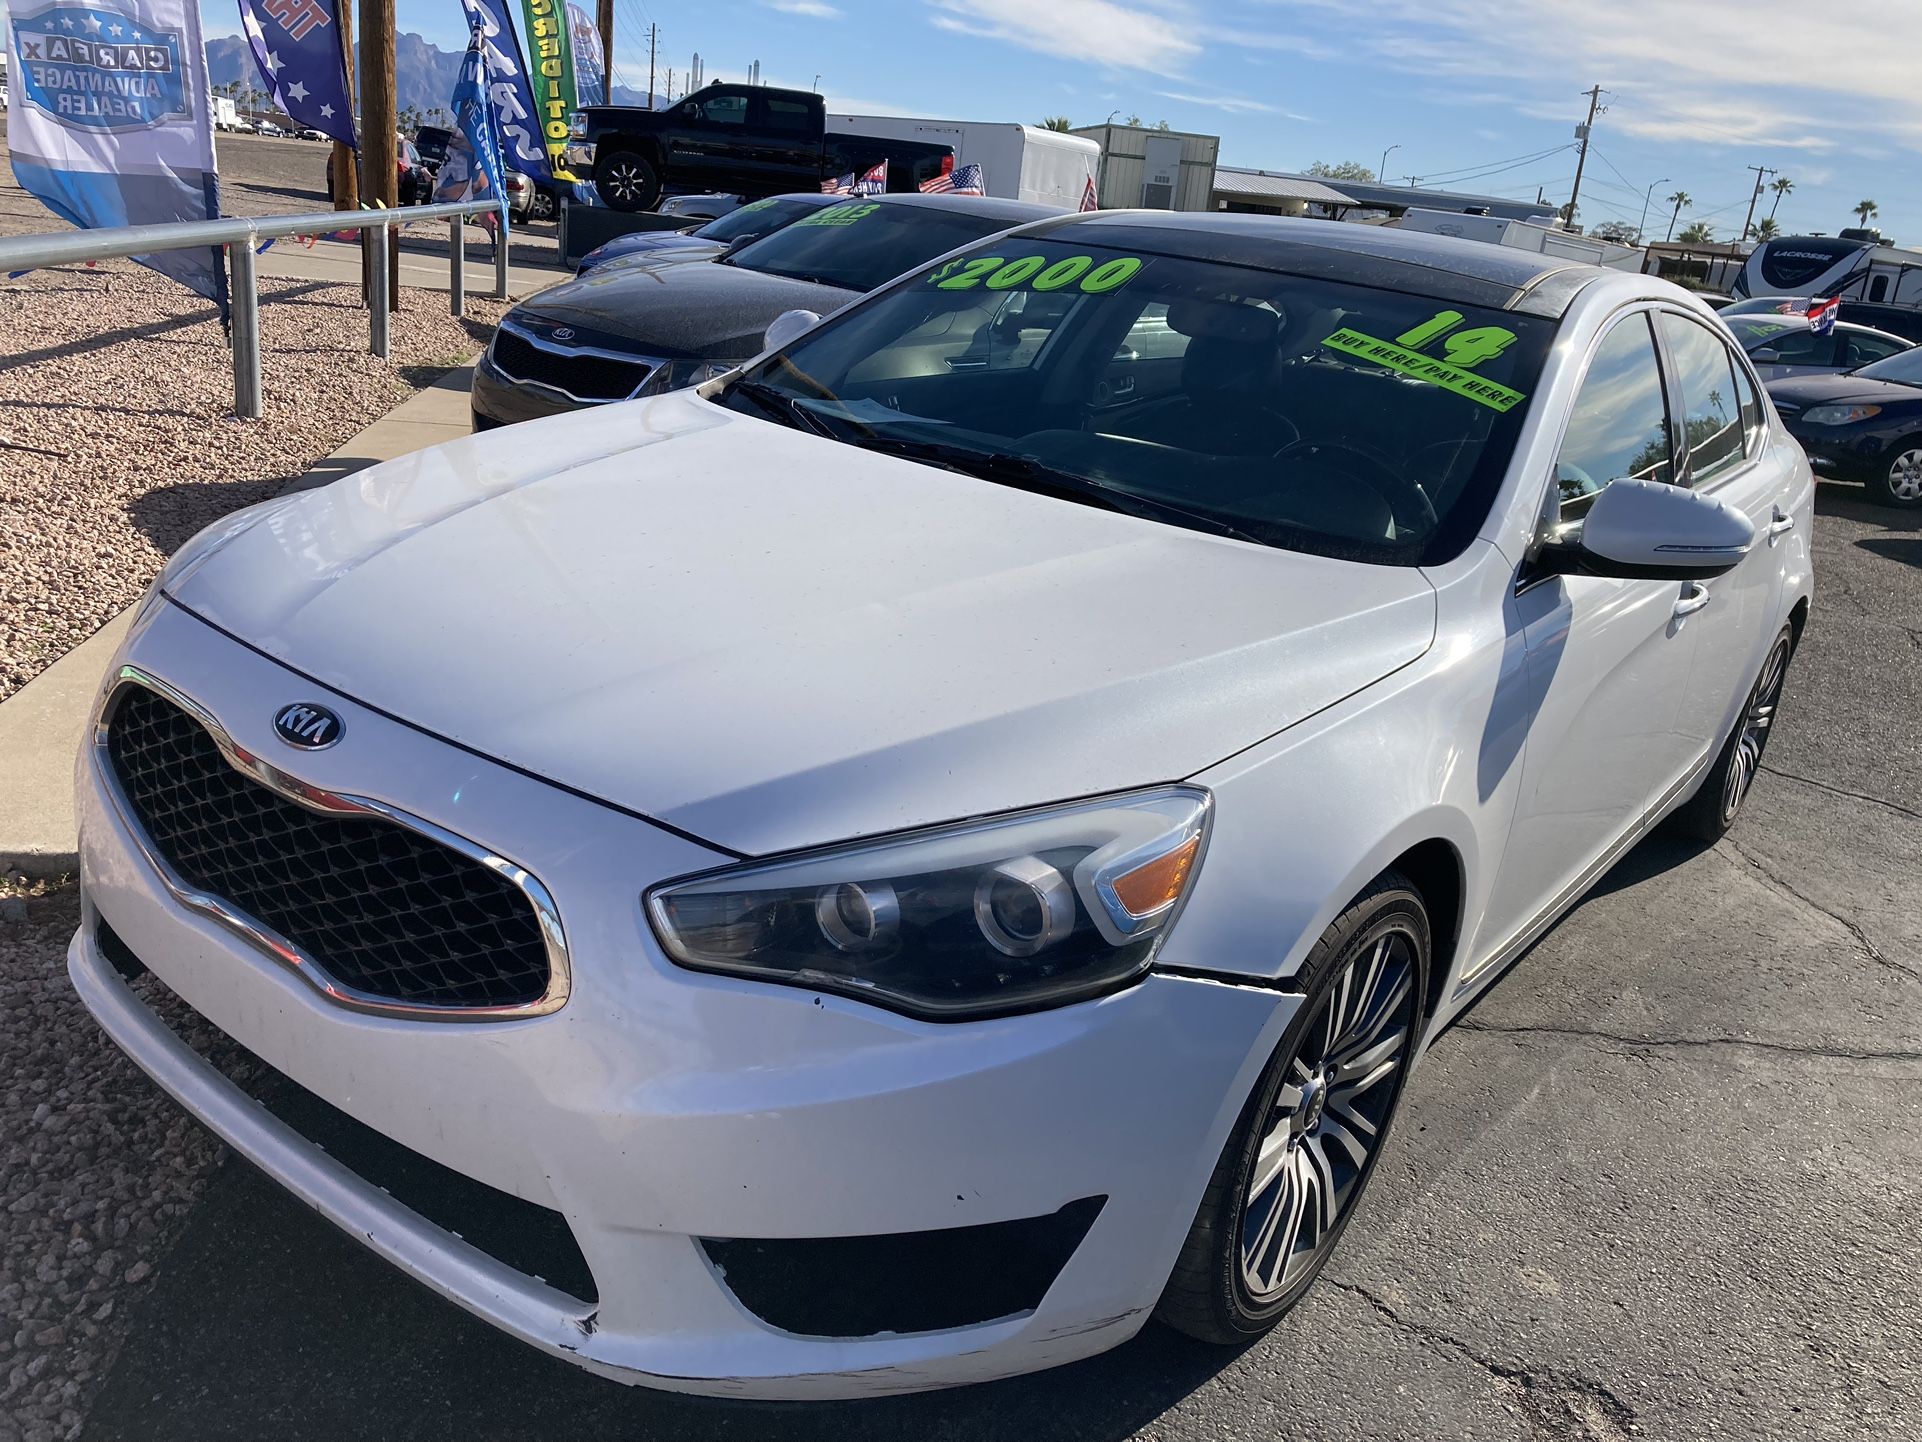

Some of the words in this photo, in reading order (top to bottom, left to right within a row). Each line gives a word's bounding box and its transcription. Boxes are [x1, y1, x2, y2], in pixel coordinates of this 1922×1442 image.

[926, 256, 1142, 294] $2000
[1773, 250, 1833, 261] LACROSSE
[1395, 309, 1518, 368] 14
[1330, 332, 1372, 349] BUY
[1367, 345, 1465, 385] HERE/PAY
[1461, 379, 1520, 408] HERE
[278, 704, 332, 744] KIA
